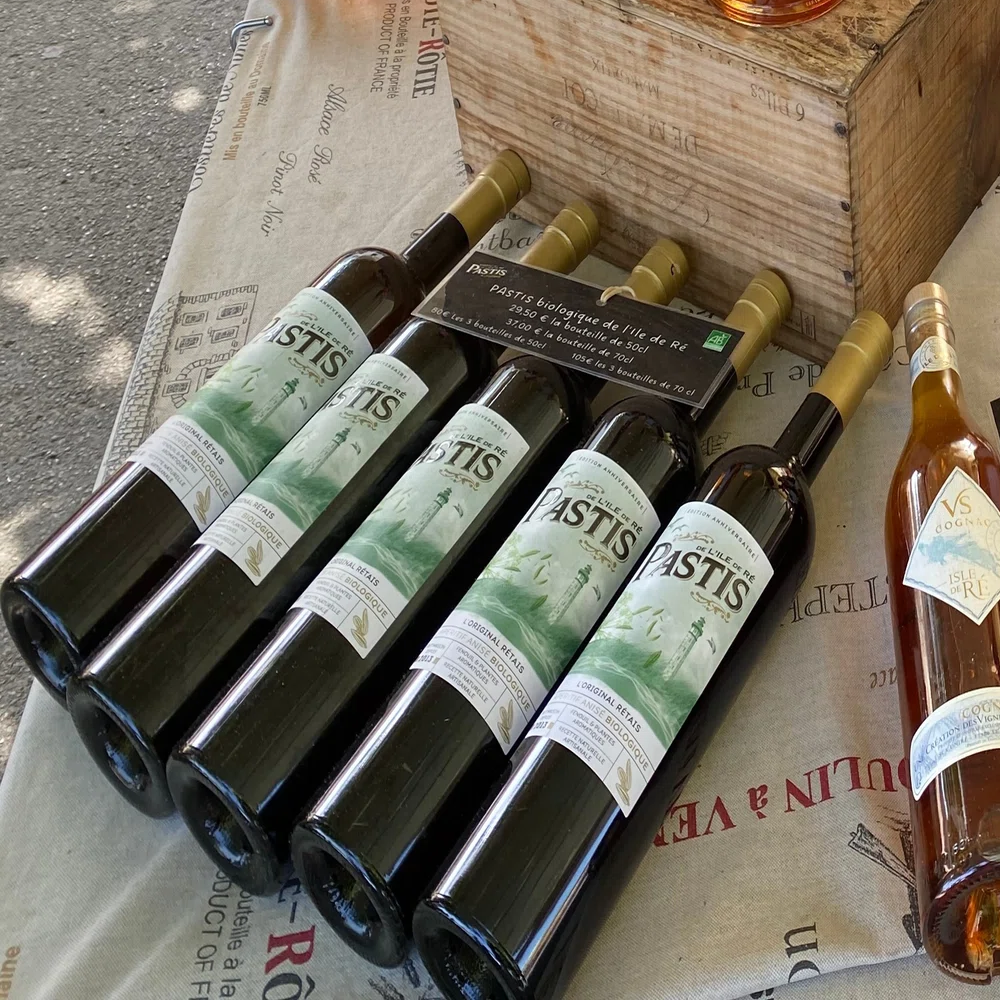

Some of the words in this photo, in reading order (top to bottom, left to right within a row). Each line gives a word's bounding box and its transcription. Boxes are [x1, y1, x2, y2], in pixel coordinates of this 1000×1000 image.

[379, 3, 397, 40] PRODUCT
[396, 15, 412, 47] Bouteille
[369, 59, 389, 93] FRANCE
[386, 64, 402, 99] propriété
[318, 83, 346, 136] Alsace
[222, 145, 239, 161] Mis
[308, 144, 333, 185] Rosé
[270, 151, 297, 196] Pinot
[260, 200, 285, 238] Noir
[465, 263, 508, 277] PASTIS
[473, 320, 513, 340] bouteilles
[526, 338, 547, 350] 50cl
[489, 284, 535, 304] PASTIS
[536, 296, 600, 326] biologique
[602, 319, 620, 332] de
[649, 334, 667, 346] de
[669, 340, 689, 353] Ré
[508, 303, 538, 319] 29,50
[539, 314, 549, 323] €
[550, 317, 561, 327] la
[563, 320, 608, 342] bouteille
[609, 335, 623, 348] de
[625, 341, 650, 354] 50cl
[534, 327, 543, 335] €
[543, 330, 553, 339] la
[556, 336, 597, 353] bouteille
[598, 348, 611, 357] de
[614, 352, 634, 364] 70cl
[571, 353, 594, 365] 105€
[616, 367, 658, 386] bouteilles
[598, 497, 622, 516] L'ILE
[940, 487, 975, 518] VS
[524, 485, 638, 563] PASTIS
[711, 513, 758, 561] ANNIVERSAIRE
[634, 542, 751, 614] PASTIS
[948, 568, 977, 585] ISLE
[456, 655, 490, 686] AROMATIQUES
[501, 646, 525, 674] RÉTAIS
[447, 672, 476, 701] ARTISANALE
[462, 679, 489, 704] NATURELLE
[489, 654, 531, 712] BIOLOGIQUE
[575, 679, 615, 708] L'ORIGINAL
[615, 704, 642, 733] RÉTAIS
[593, 725, 615, 747] PLANTES
[604, 715, 649, 772] BIOLOGIQUE
[925, 723, 961, 755] CRÉATION
[746, 783, 769, 819] à
[194, 943, 217, 973] OF
[219, 976, 237, 999] la
